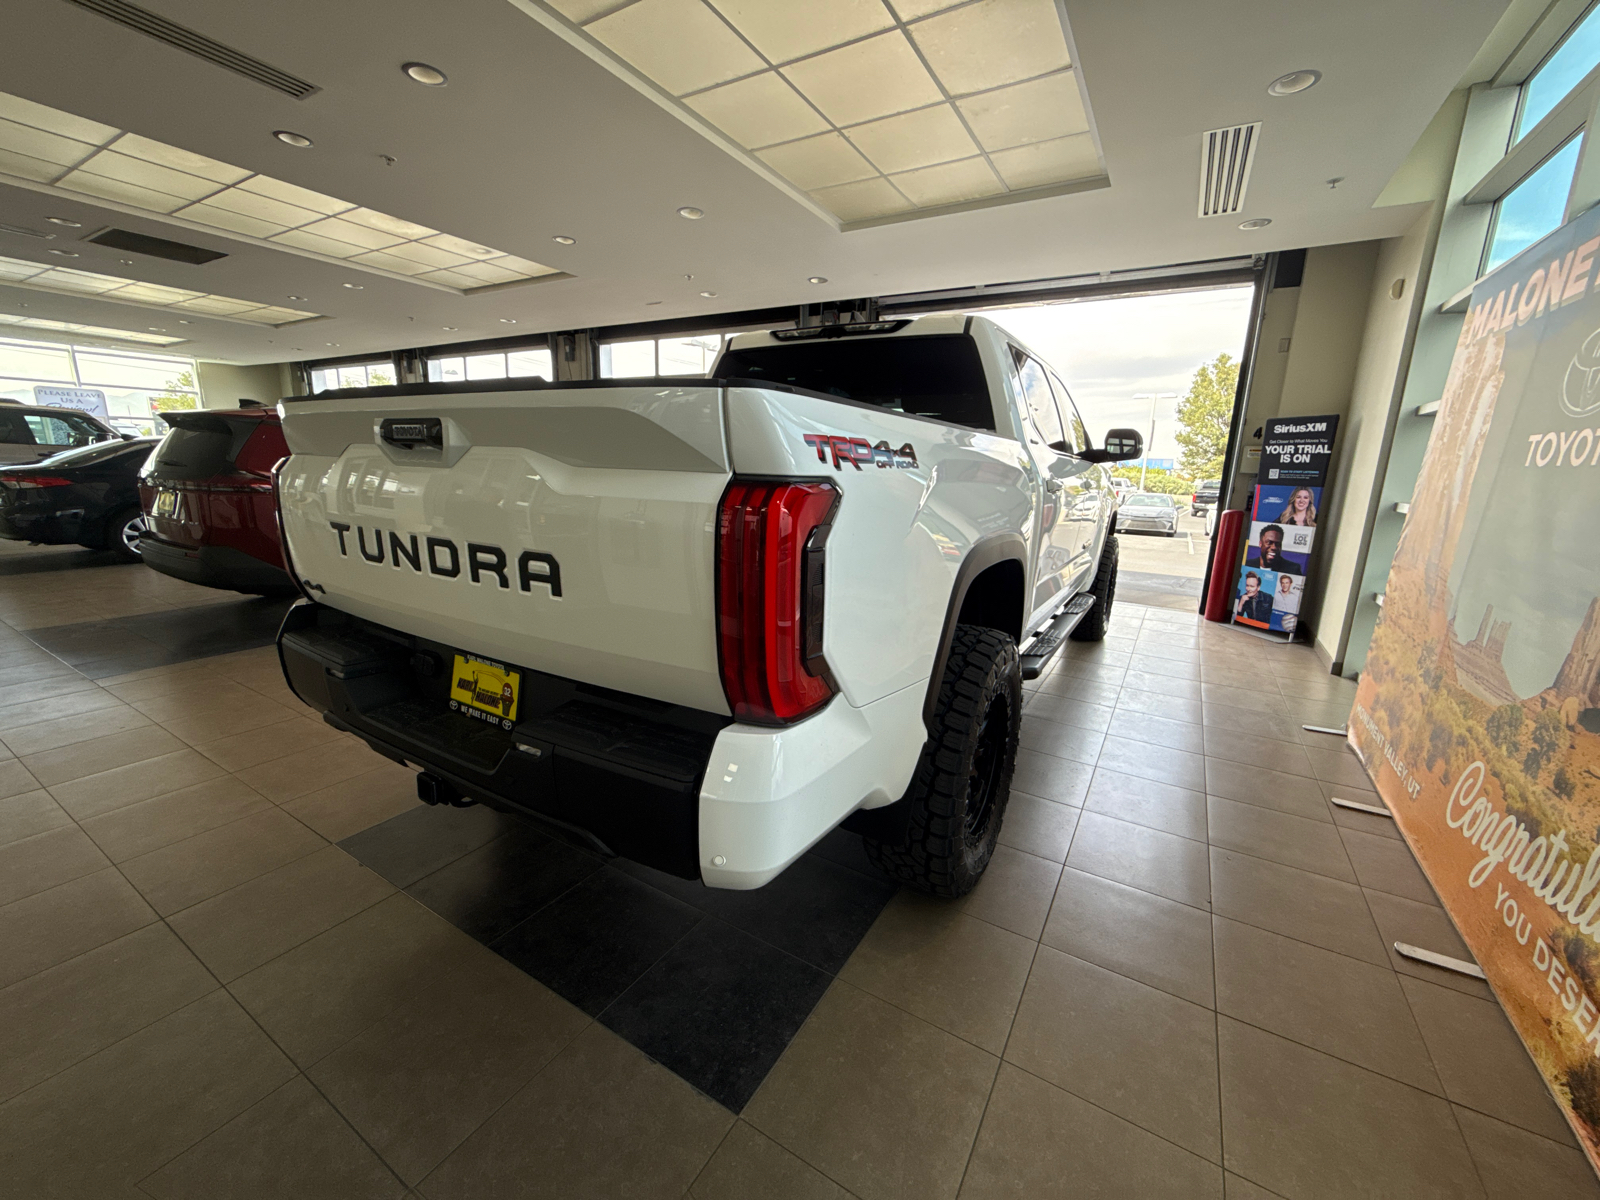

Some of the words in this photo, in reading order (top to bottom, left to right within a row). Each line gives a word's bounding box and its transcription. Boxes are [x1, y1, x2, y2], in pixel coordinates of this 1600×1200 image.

[1466, 235, 1600, 345] MALONE
[1253, 426, 1263, 439] 4
[1273, 422, 1327, 434] SiriusXM
[803, 434, 875, 471] TRD
[1265, 445, 1295, 454] YOUR
[1297, 444, 1331, 454] TRIAL
[876, 460, 892, 469] OFF
[896, 460, 919, 469] ROAD
[1280, 454, 1291, 463] IS
[1293, 454, 1311, 463] ON
[1294, 534, 1307, 542] LOL
[329, 521, 562, 598] TUNDRA
[504, 686, 511, 696] 32
[461, 705, 468, 713] WE
[469, 707, 481, 718] MAKE
[481, 712, 487, 720] IT
[487, 714, 499, 725] EASY
[1356, 703, 1385, 748] MONUMENT
[1384, 741, 1408, 787] VALLEY,
[1408, 775, 1420, 799] UT
[1494, 882, 1532, 945] YOU
